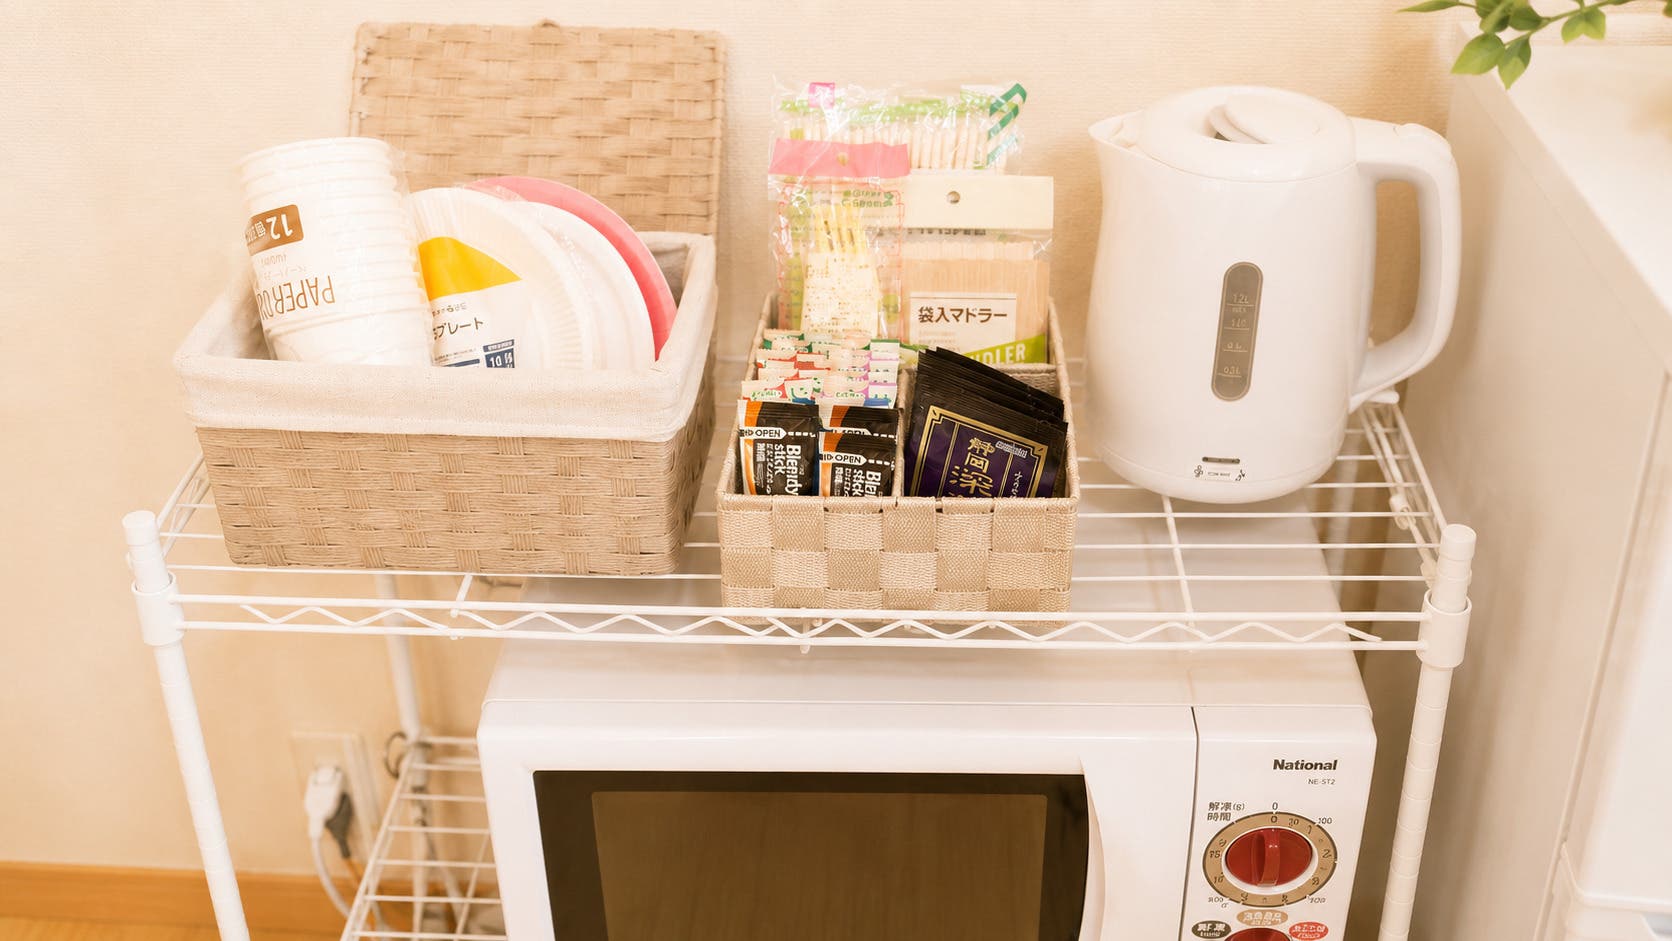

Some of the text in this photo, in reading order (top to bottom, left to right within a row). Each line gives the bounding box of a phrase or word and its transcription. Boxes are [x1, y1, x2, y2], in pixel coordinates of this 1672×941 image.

[918, 306, 1008, 324] 袋入マドラー
[755, 428, 781, 438] OPEN
[774, 444, 785, 475] stick
[835, 454, 862, 464] OPEN
[1273, 759, 1338, 771] National
